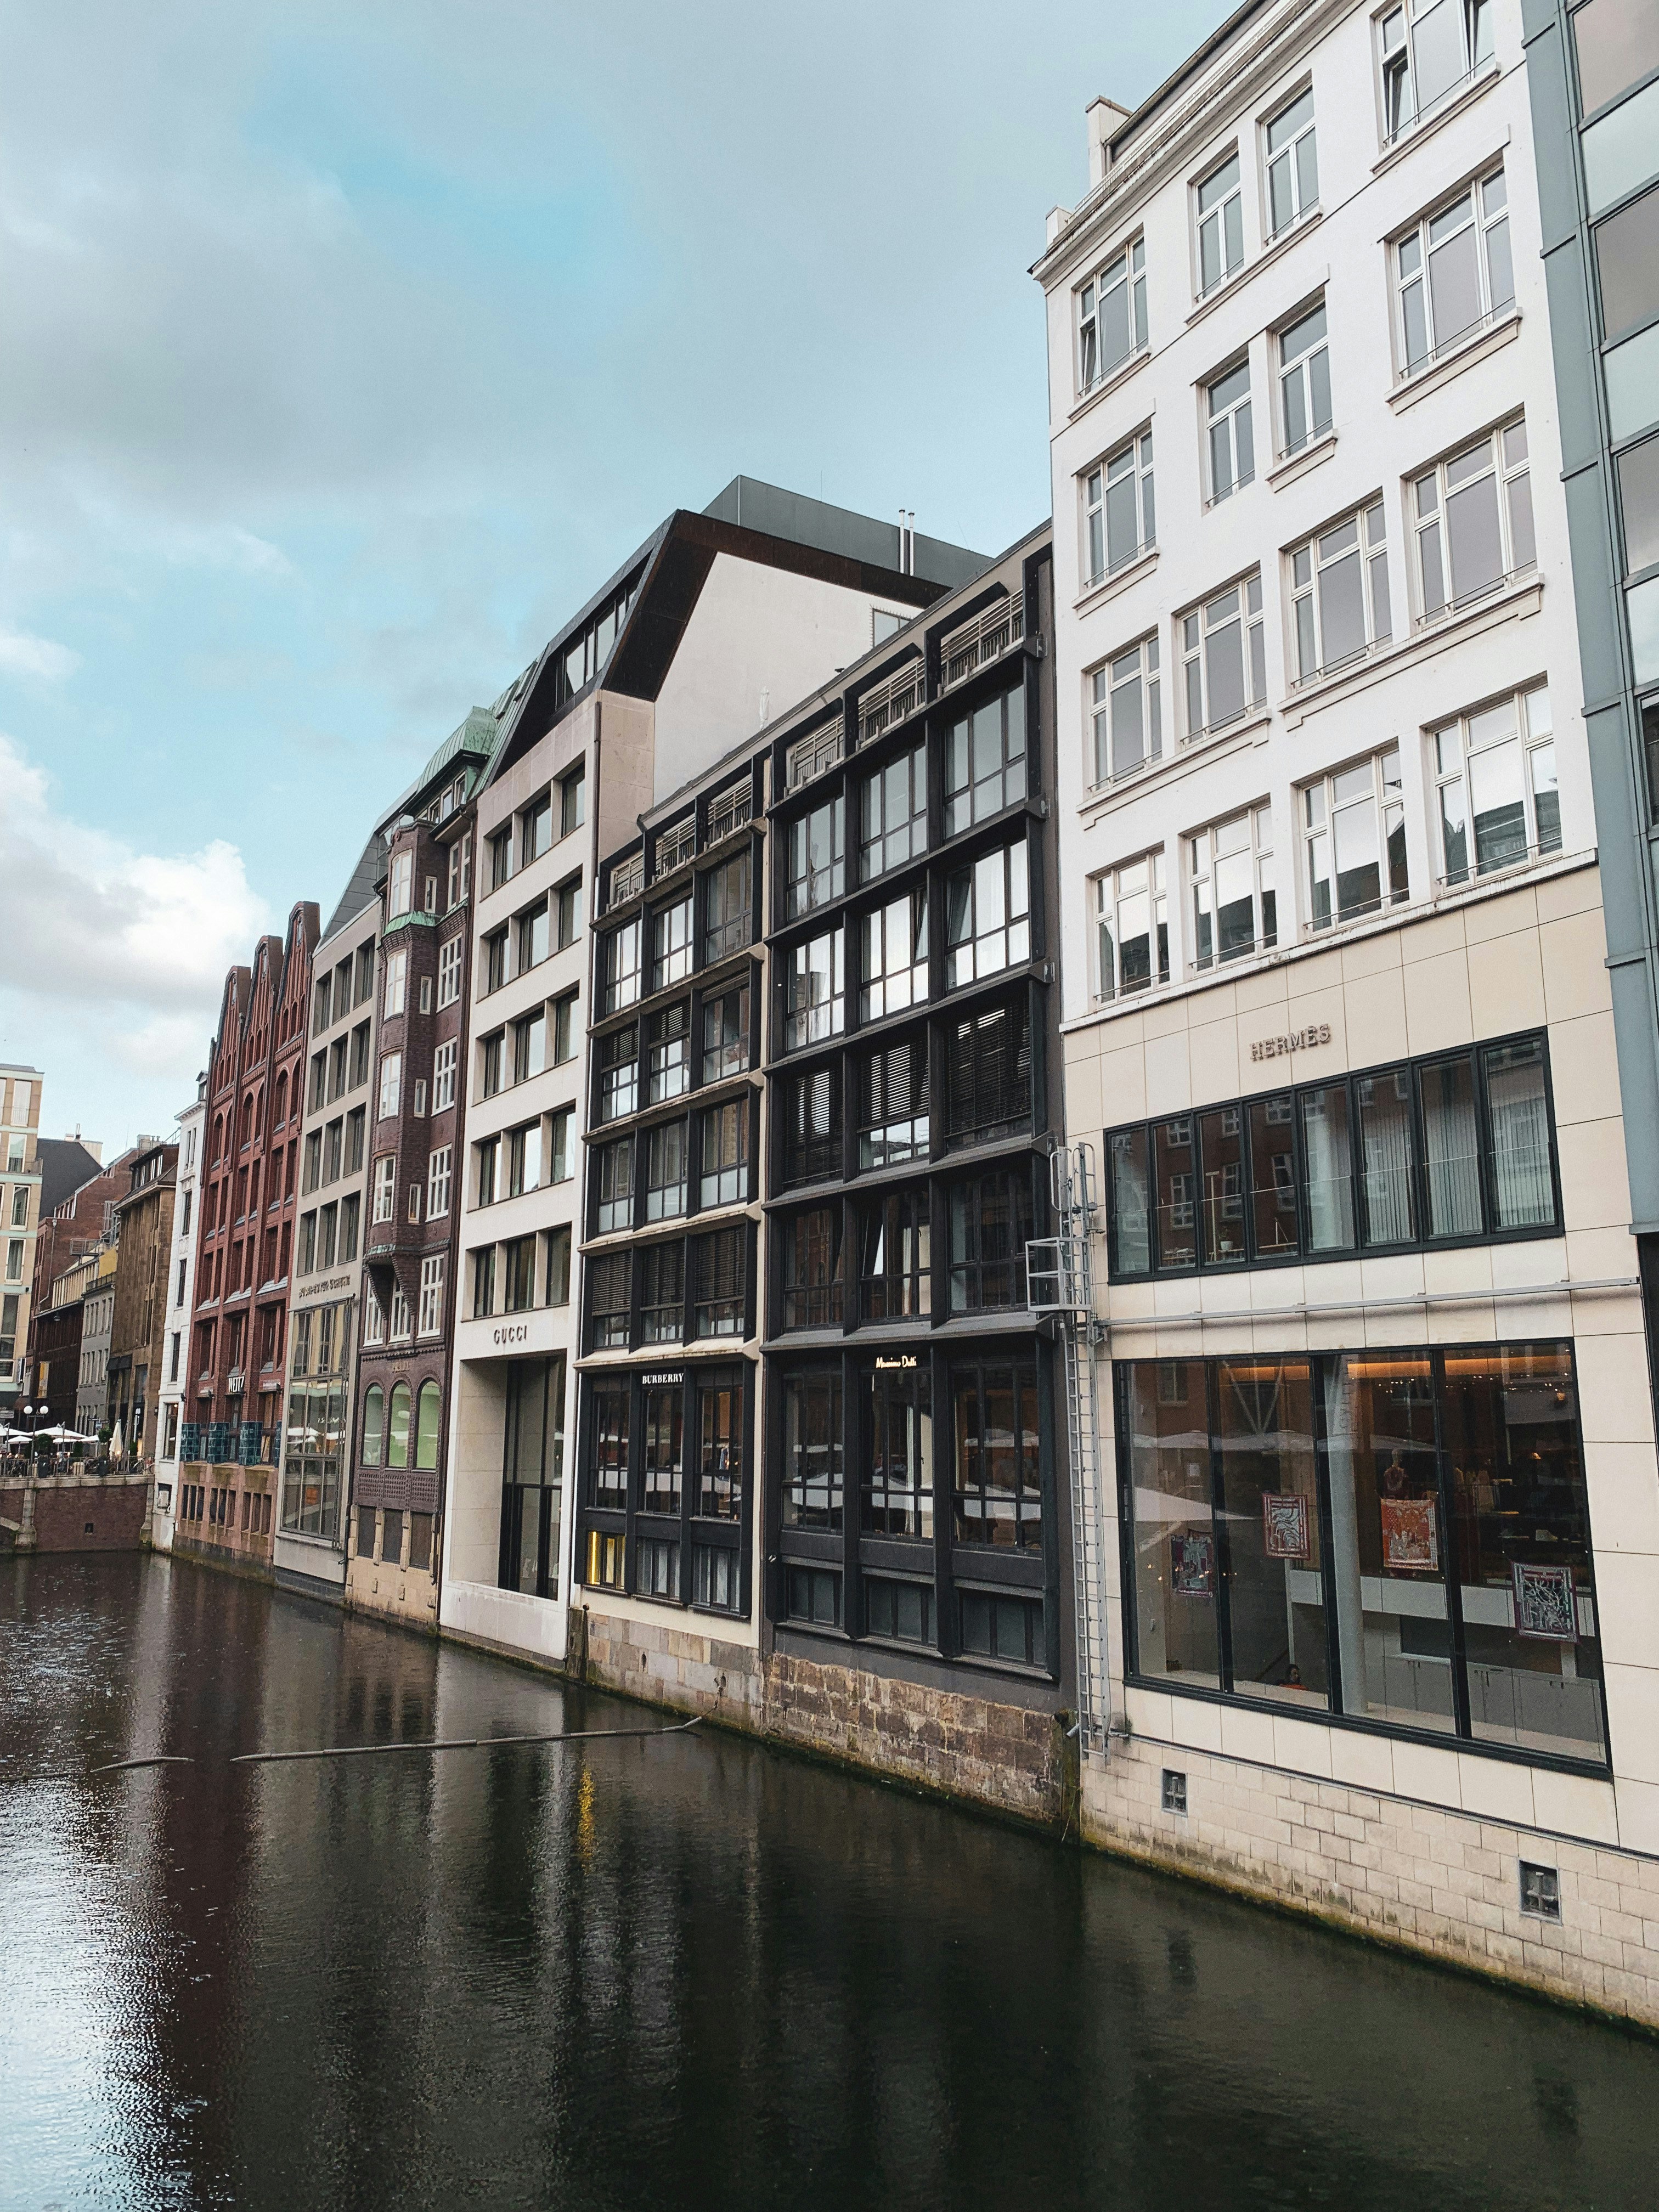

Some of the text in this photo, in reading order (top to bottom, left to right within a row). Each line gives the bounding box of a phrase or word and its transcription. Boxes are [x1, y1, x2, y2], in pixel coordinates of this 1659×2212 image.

[1250, 1023, 1330, 1062] HERMÈS
[494, 1325, 527, 1345] GUCCI
[642, 1373, 684, 1385] BURBERRY
